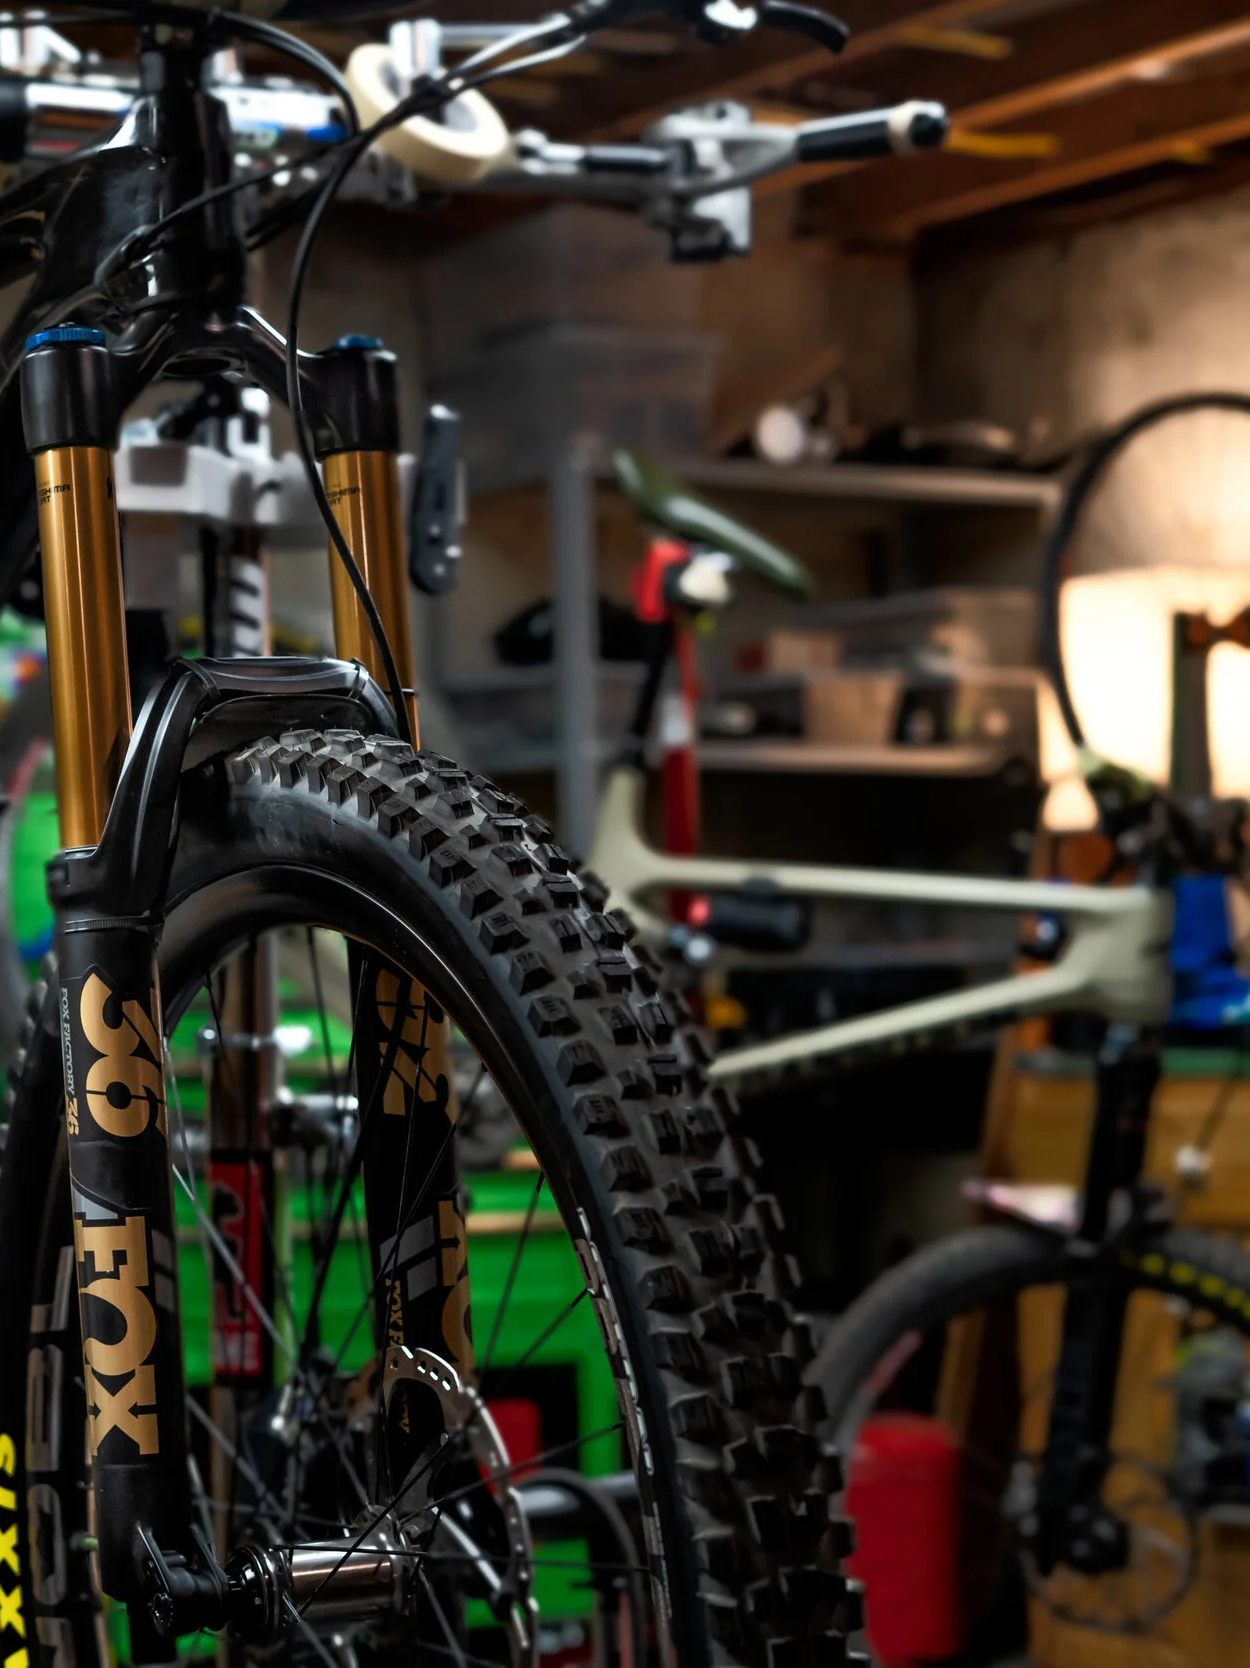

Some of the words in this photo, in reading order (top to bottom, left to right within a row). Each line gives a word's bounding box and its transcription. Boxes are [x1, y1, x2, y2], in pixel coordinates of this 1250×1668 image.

[61, 987, 71, 1023] FOX
[64, 1023, 75, 1095] FACTORY
[80, 973, 166, 1138] 36
[67, 1097, 79, 1135] 36
[73, 1215, 160, 1457] FOX
